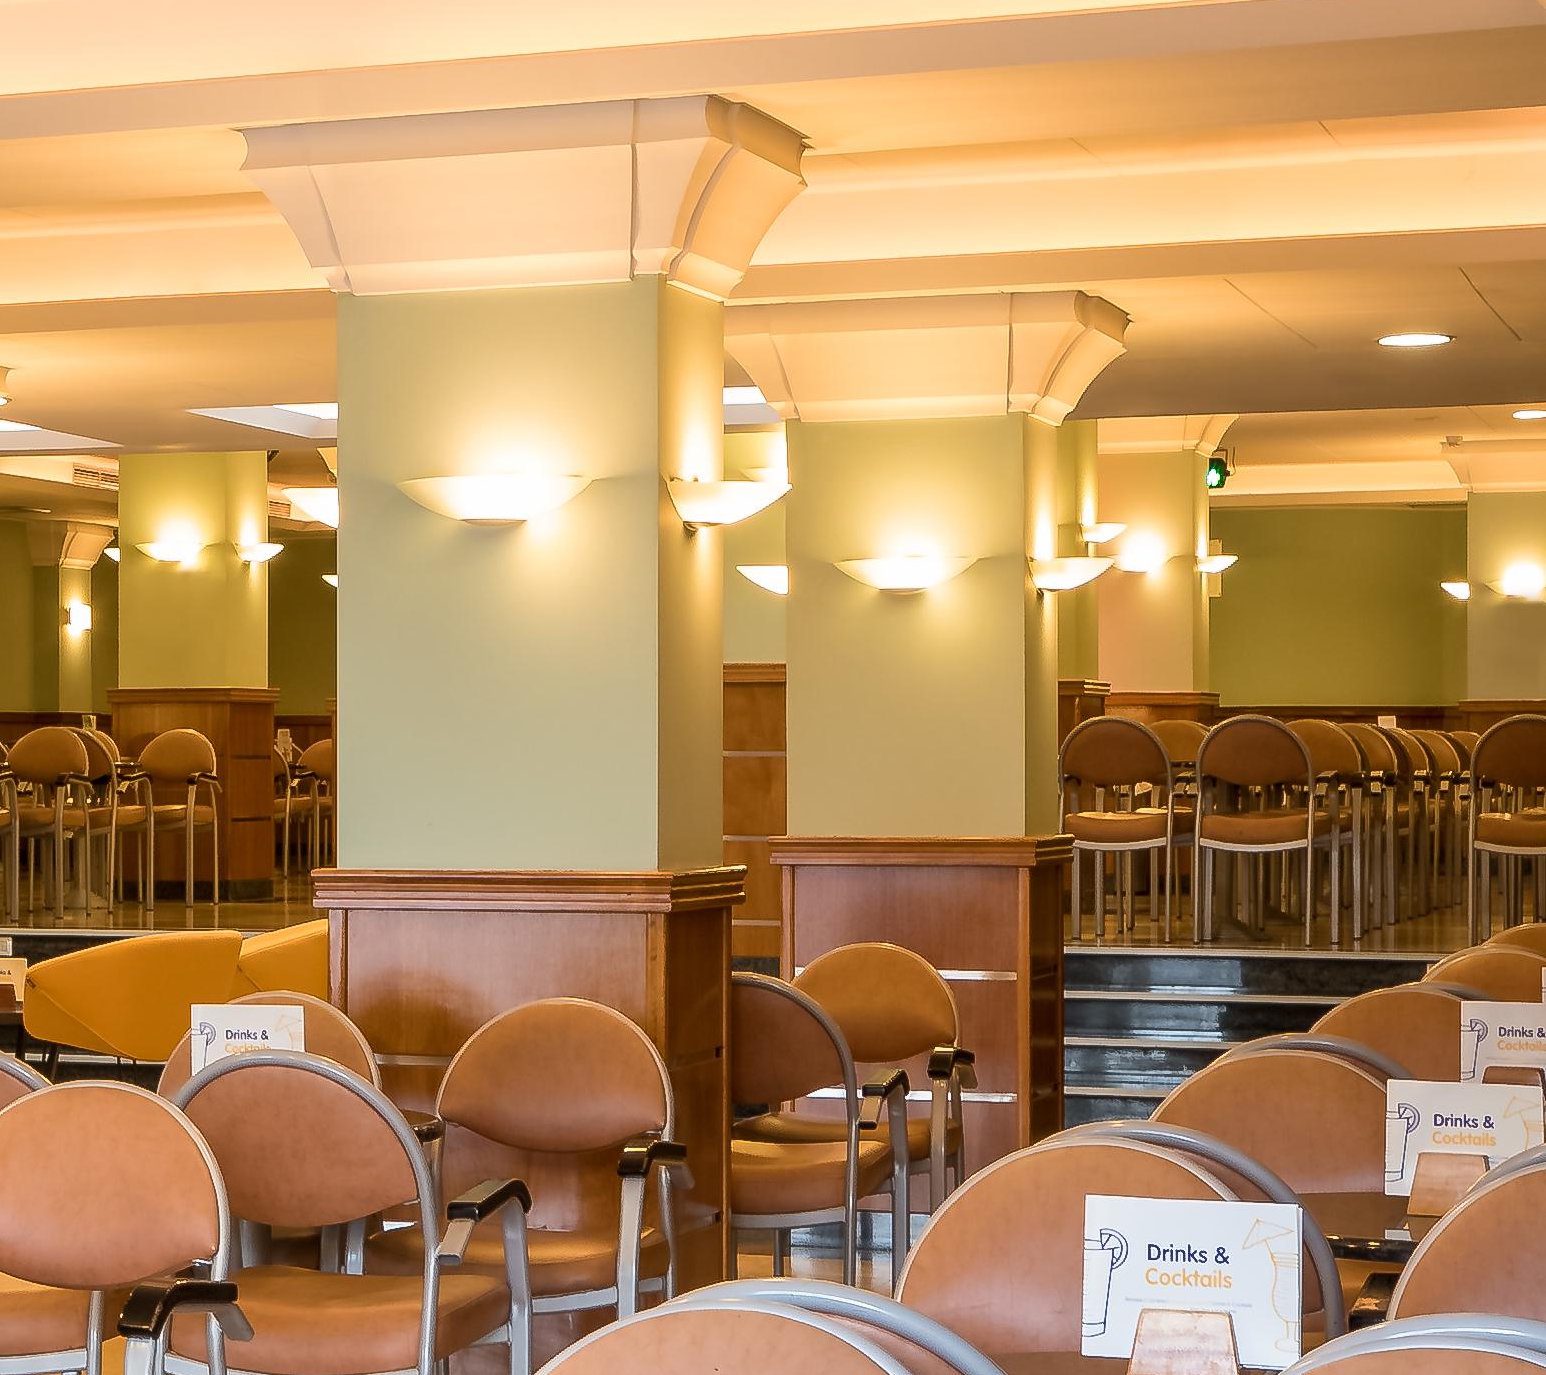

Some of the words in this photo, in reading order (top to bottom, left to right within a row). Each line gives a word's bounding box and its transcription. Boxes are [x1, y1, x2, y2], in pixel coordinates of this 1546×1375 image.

[225, 1029, 258, 1040] Drinks
[260, 1029, 269, 1040] &
[1498, 1025, 1534, 1038] Drinks
[1536, 1027, 1546, 1038] &
[1433, 1113, 1479, 1129] Drinks
[1483, 1115, 1495, 1129] &
[1432, 1130, 1497, 1147] Cocktails
[1147, 1243, 1208, 1264] Drinks
[1214, 1246, 1230, 1265] &
[1144, 1267, 1233, 1289] Cocktails
